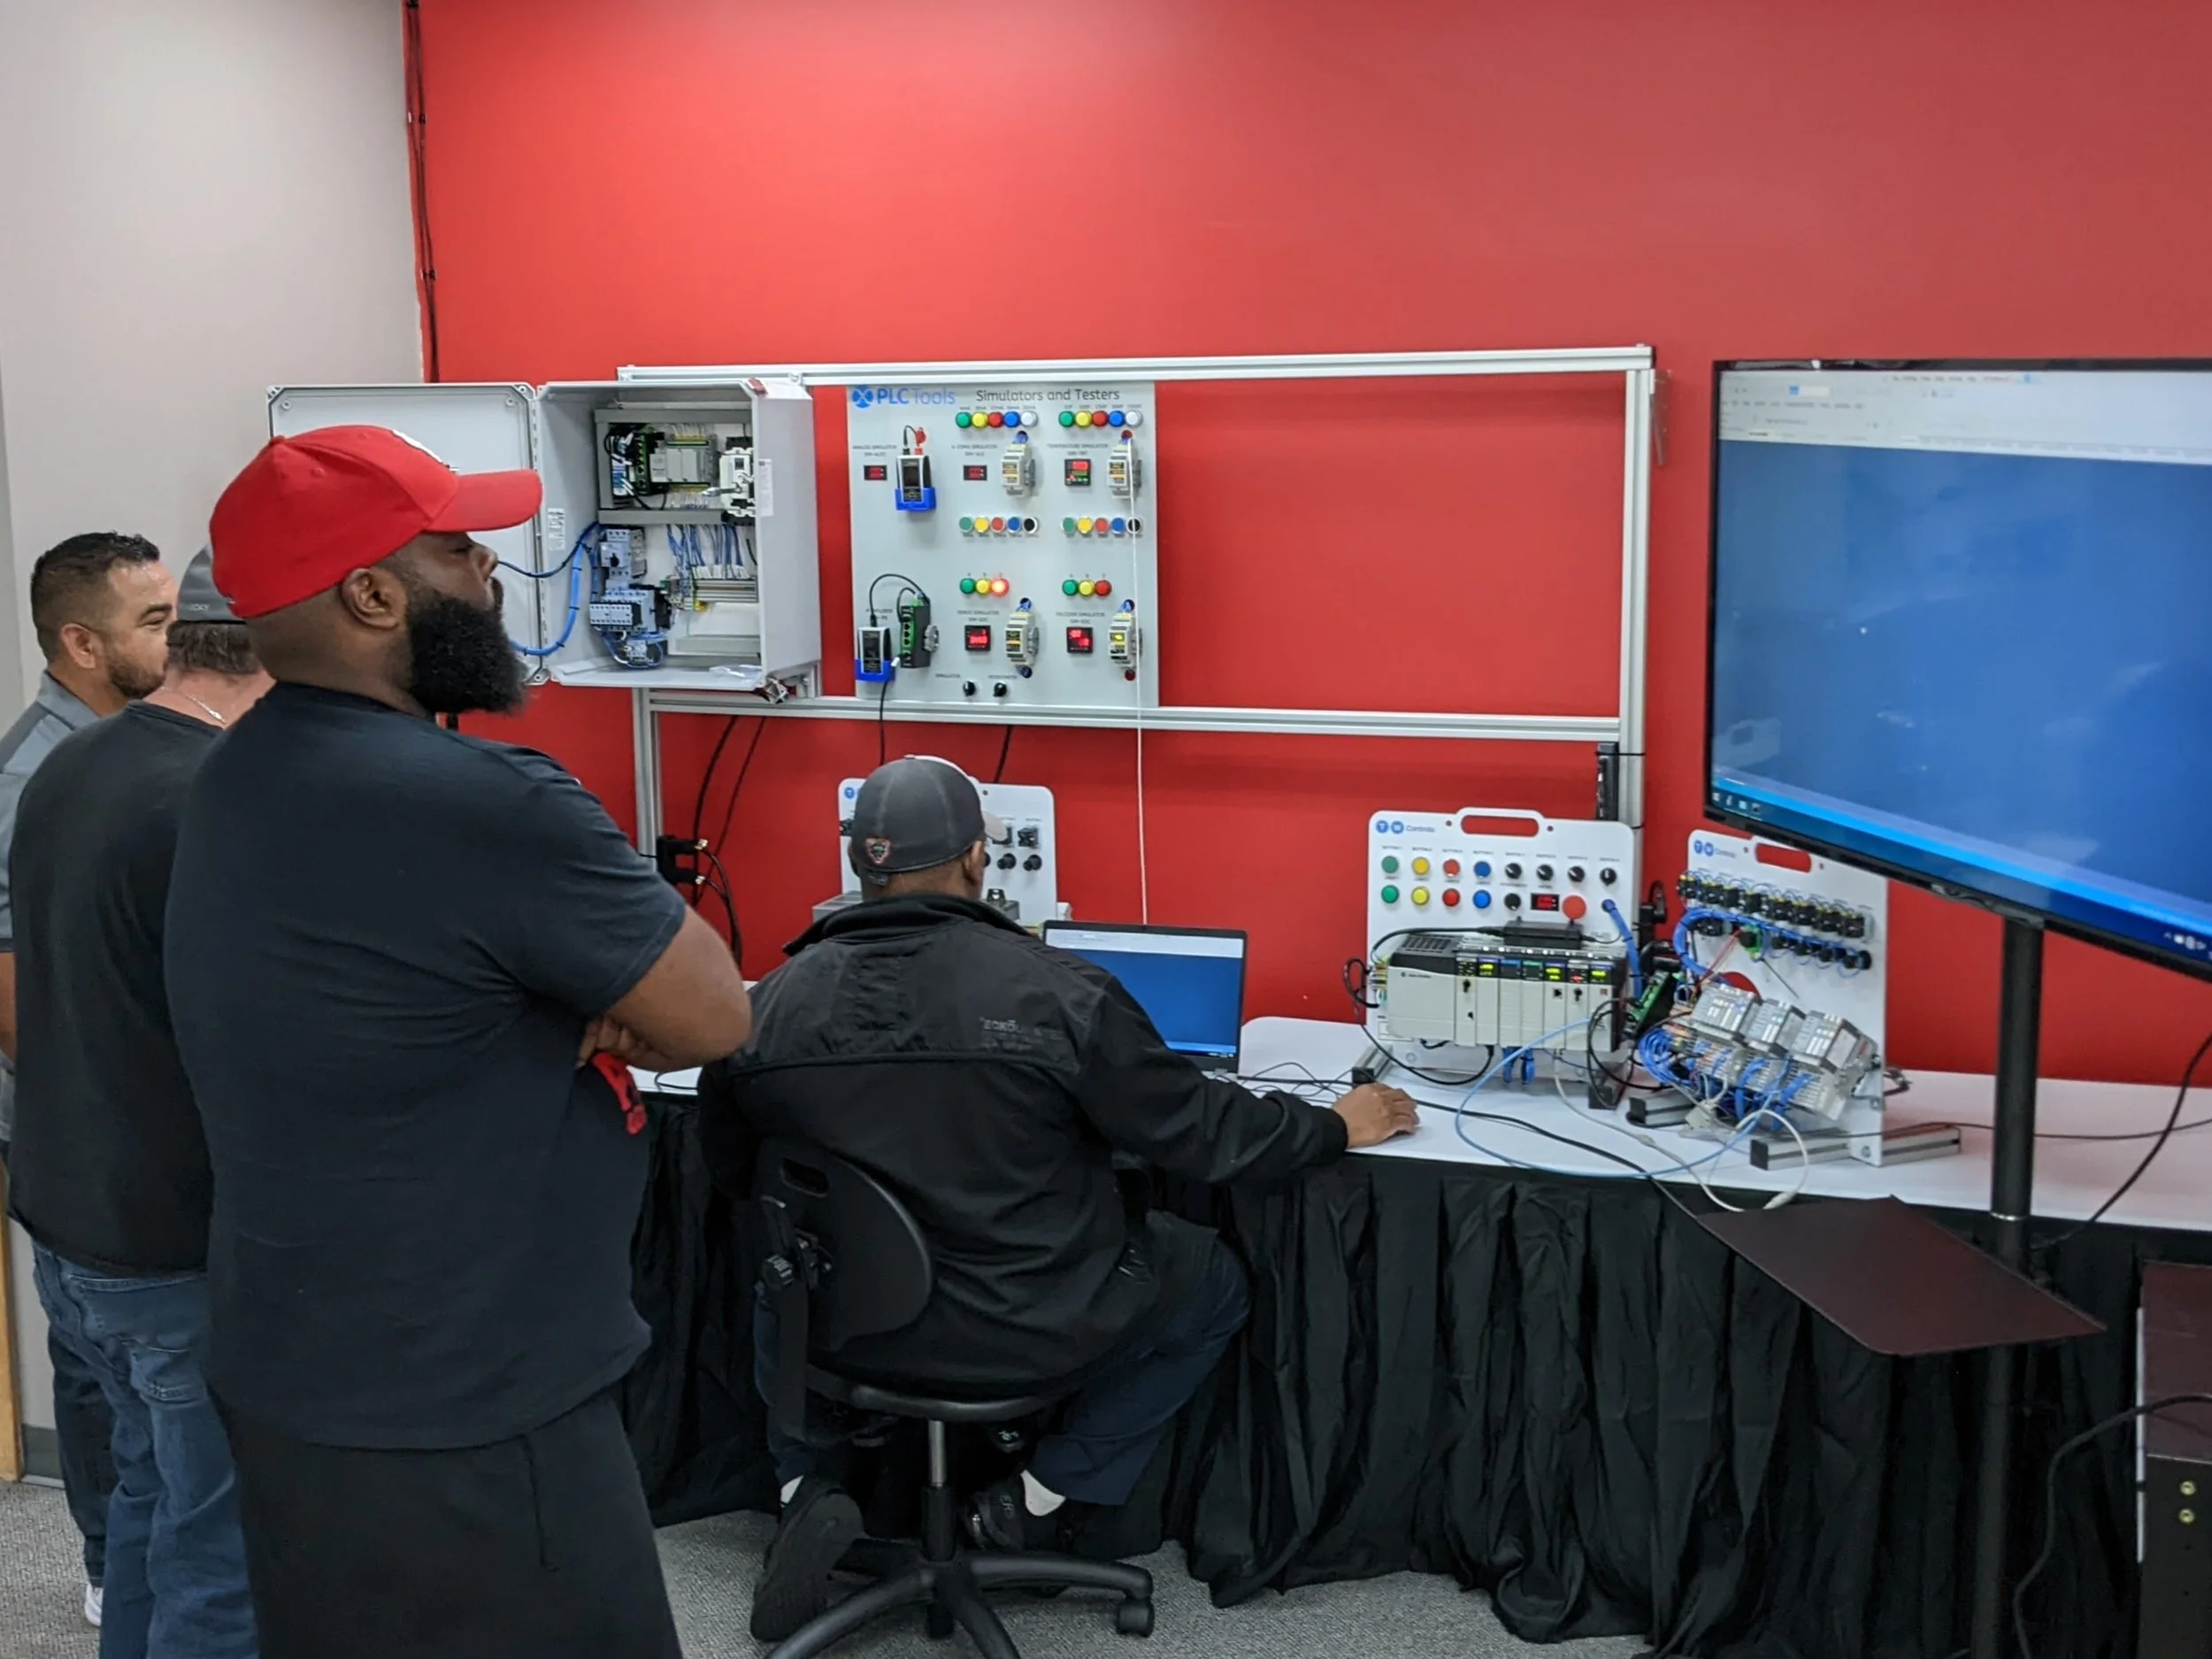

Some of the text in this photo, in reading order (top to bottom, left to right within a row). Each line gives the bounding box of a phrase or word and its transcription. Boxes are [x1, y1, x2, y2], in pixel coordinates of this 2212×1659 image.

[877, 387, 956, 404] PLC Tools
[976, 388, 1120, 402] Simulators and Testers
